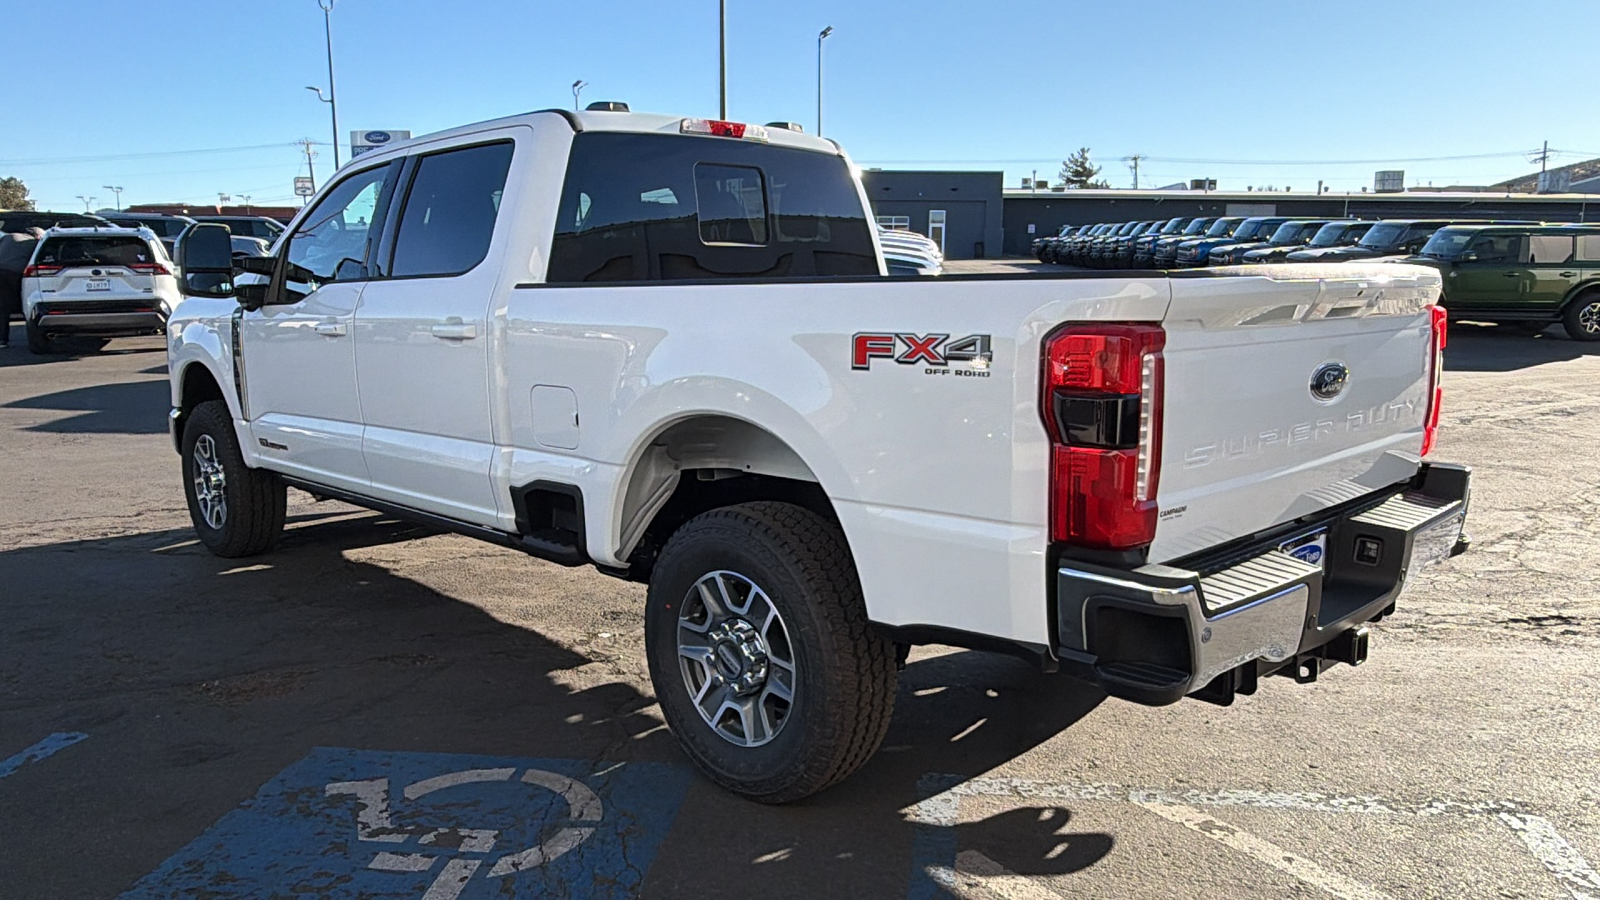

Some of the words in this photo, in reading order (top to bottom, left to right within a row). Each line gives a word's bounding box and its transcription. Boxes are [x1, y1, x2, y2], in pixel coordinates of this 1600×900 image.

[851, 331, 993, 371] FX4
[925, 368, 950, 376] OFF
[1321, 370, 1343, 393] Ford
[1182, 419, 1334, 471] SUPER
[1345, 395, 1422, 432] DUTY
